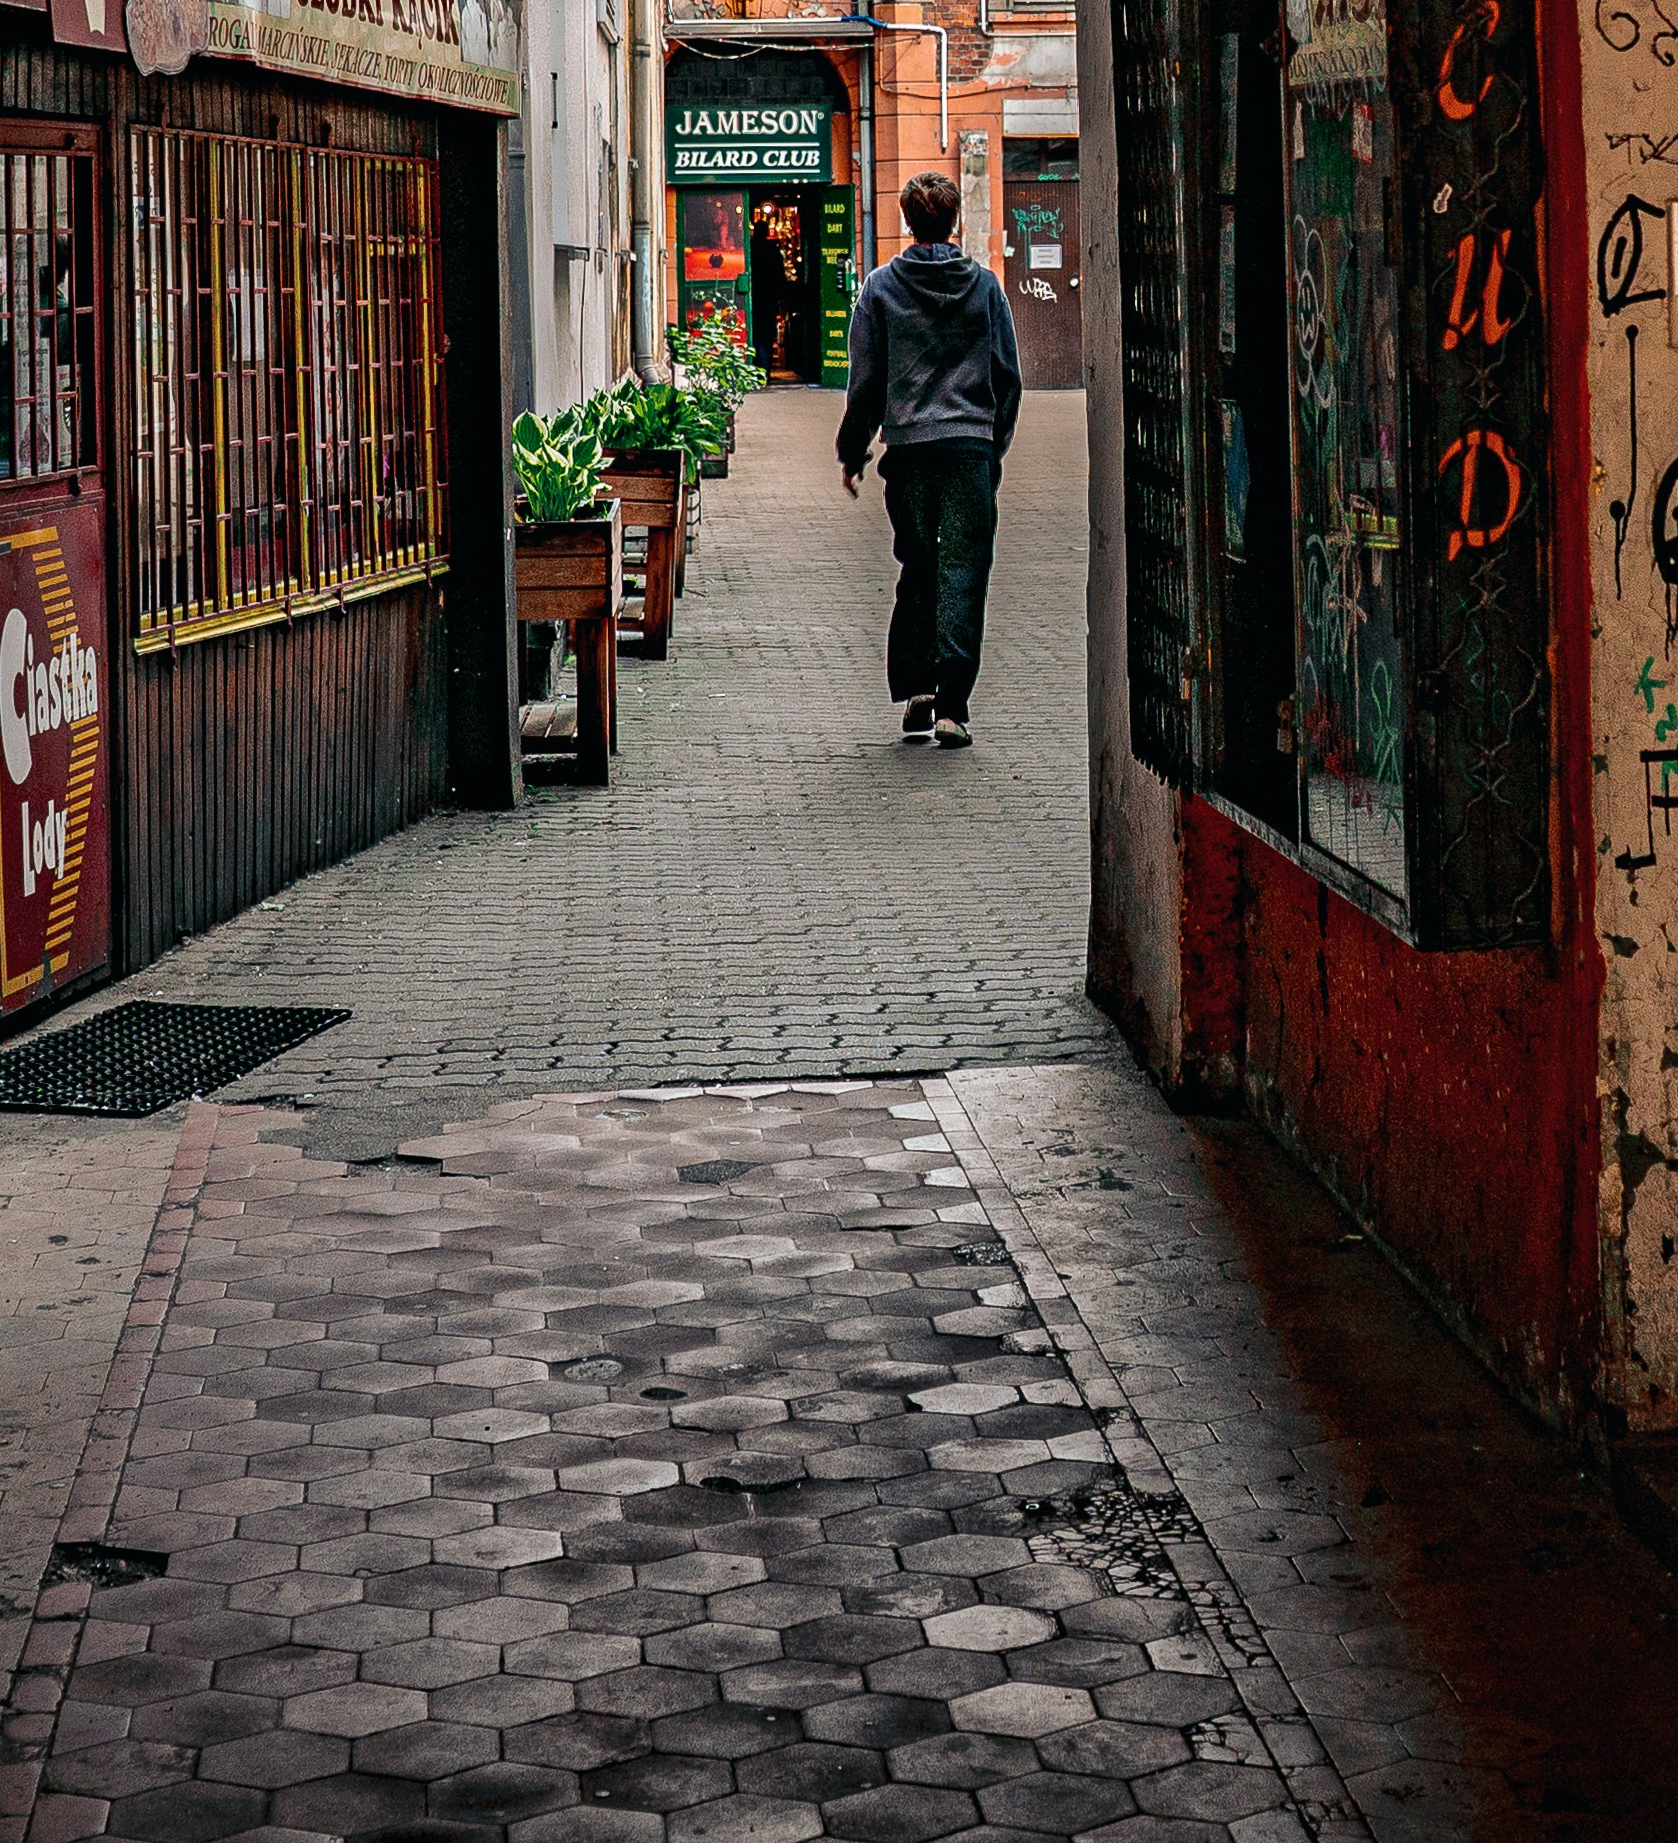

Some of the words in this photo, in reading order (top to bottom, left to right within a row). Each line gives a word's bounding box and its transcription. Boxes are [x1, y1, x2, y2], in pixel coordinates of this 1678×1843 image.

[384, 54, 418, 87] TORTY
[418, 63, 509, 105] OKOLICZNOŚCIOWE
[674, 150, 759, 168] BILARD
[762, 150, 821, 167] CLUB
[22, 799, 67, 898] Lody
